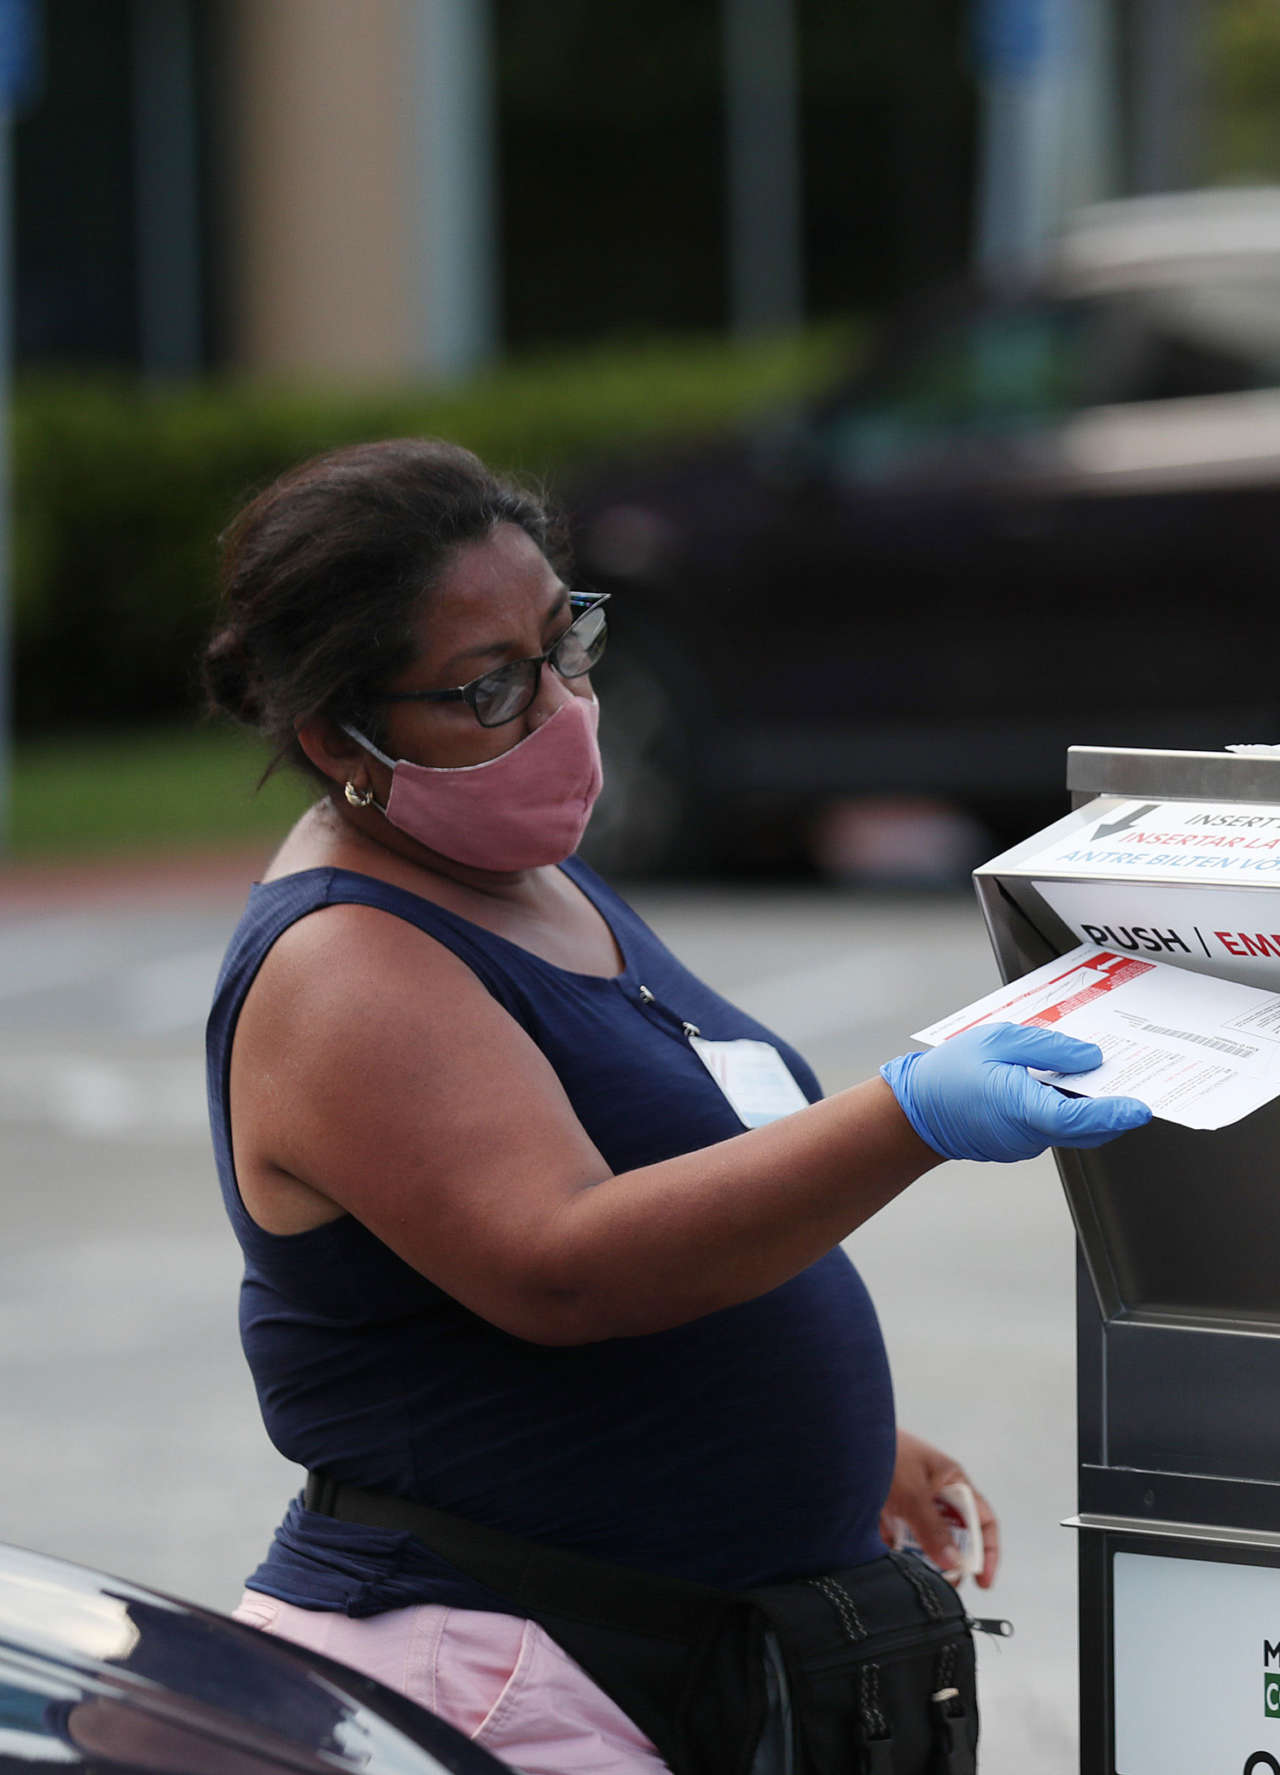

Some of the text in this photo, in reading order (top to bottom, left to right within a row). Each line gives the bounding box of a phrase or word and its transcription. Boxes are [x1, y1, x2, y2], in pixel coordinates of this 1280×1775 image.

[1185, 814, 1280, 829] INSERT
[1118, 832, 1244, 848] INSERTAR
[1244, 836, 1280, 850] LA
[1056, 850, 1147, 864] ANTRE
[1146, 854, 1240, 869] BILTEN
[1080, 924, 1192, 953] PUSH
